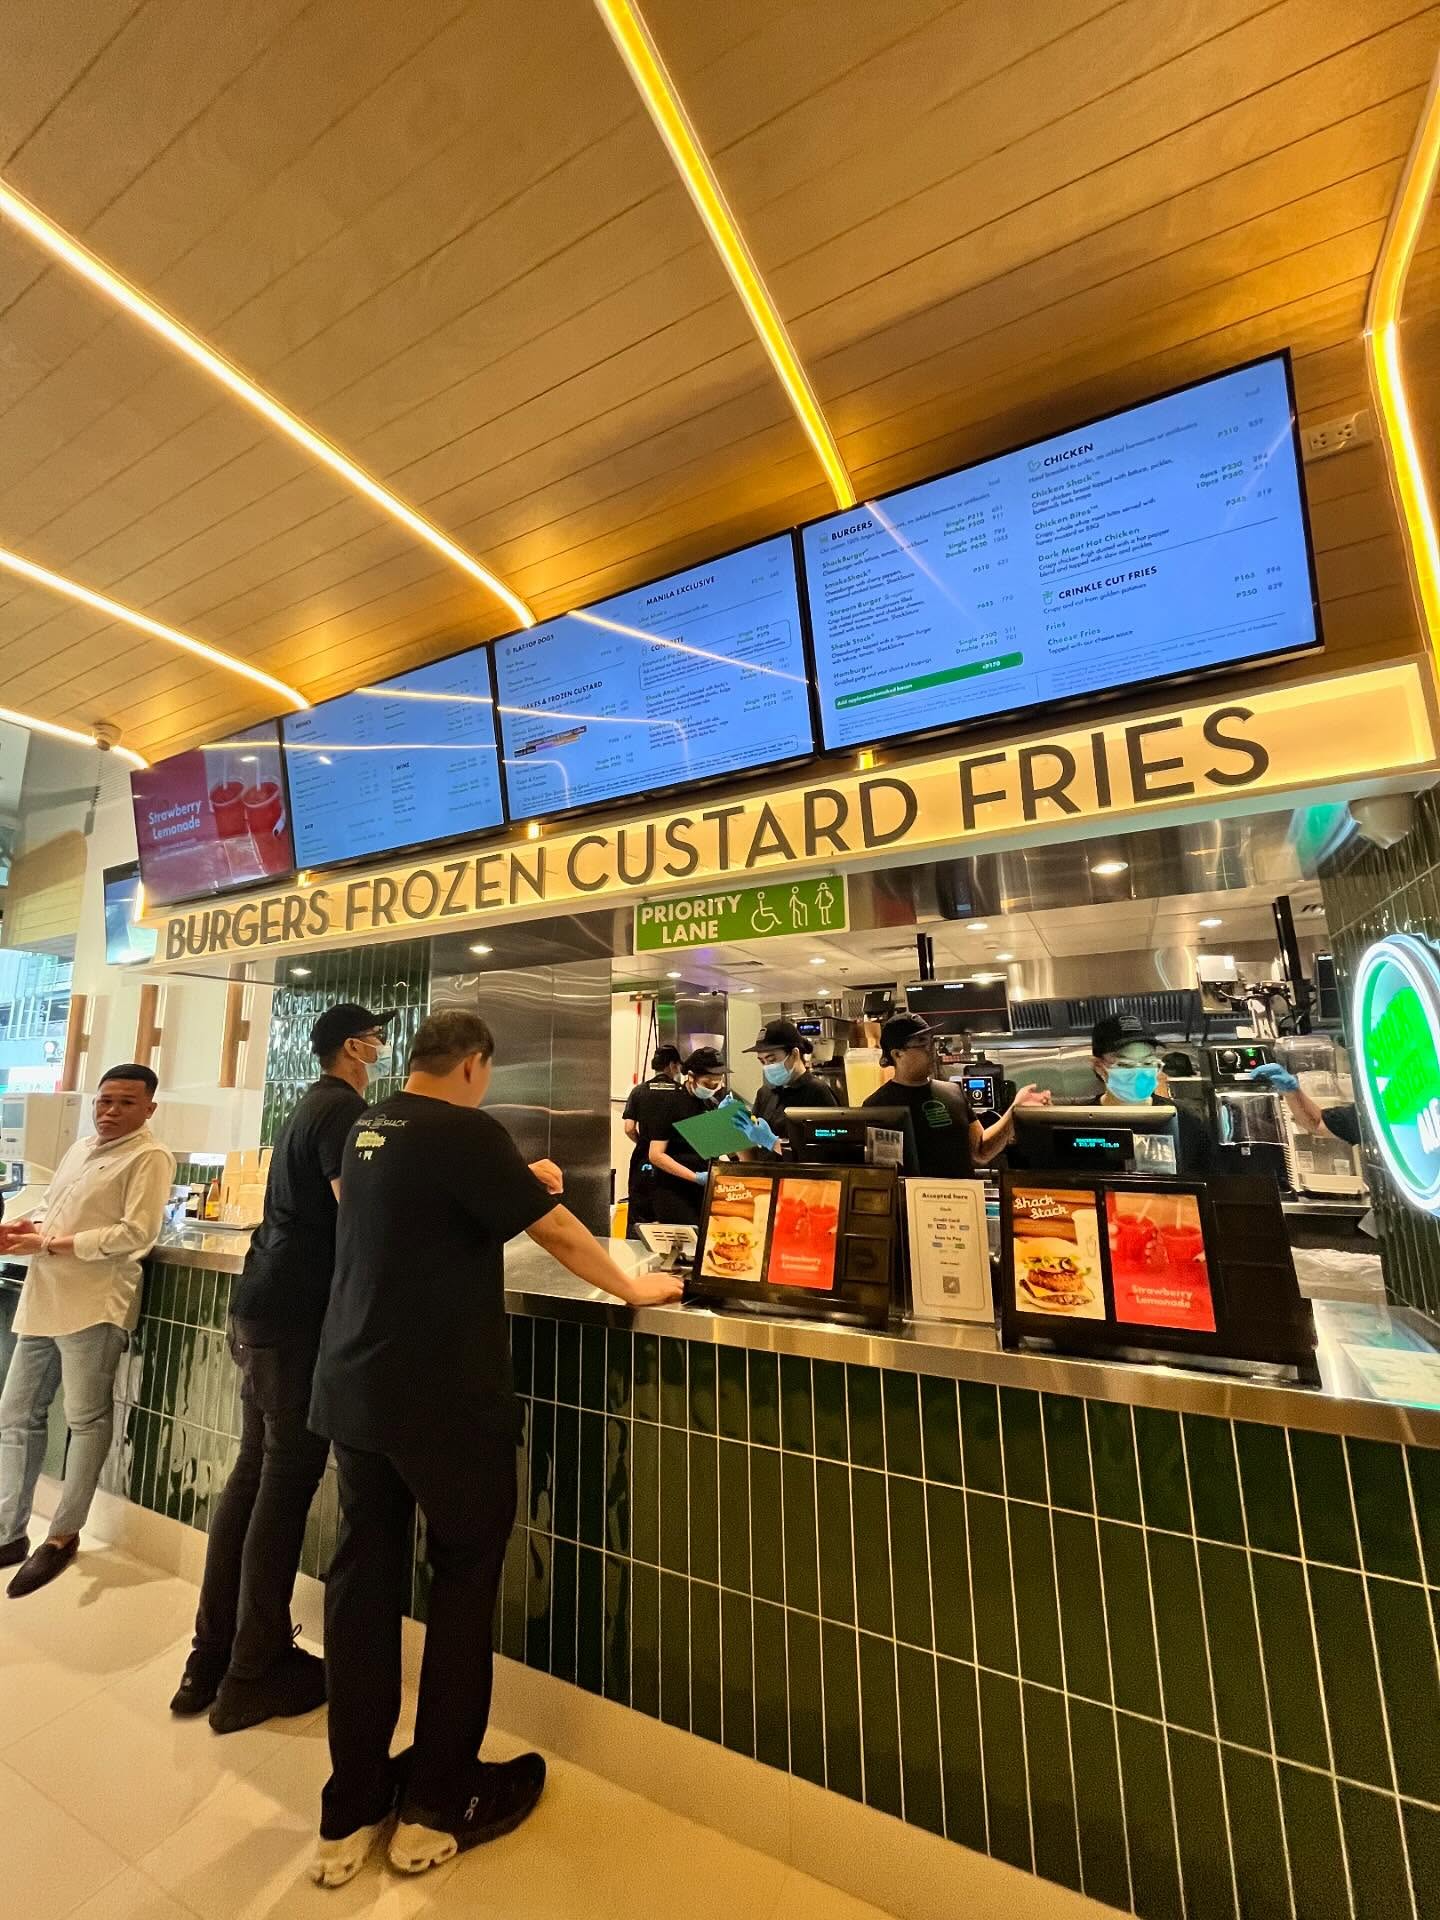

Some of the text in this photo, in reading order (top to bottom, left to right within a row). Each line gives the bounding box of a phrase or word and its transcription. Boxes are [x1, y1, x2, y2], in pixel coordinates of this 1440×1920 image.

[1043, 443, 1093, 467] CHICKEN
[1031, 483, 1064, 499] Chicken
[831, 520, 872, 540] BURGERS
[1034, 515, 1068, 531] Chicken
[1085, 523, 1099, 531] BBQ
[1038, 527, 1140, 562] Dark Meat Hot Chicken
[646, 576, 714, 605] MANILA EXCLUSIVE
[1058, 566, 1157, 599] CRINKLE CUT FRIES
[857, 597, 881, 609] Burger
[1045, 621, 1066, 631] Fries
[537, 634, 554, 644] DOGS
[1047, 627, 1101, 645] Cheese Fries
[830, 640, 851, 650] Shack
[833, 663, 873, 679] Hamburger
[547, 690, 573, 702] FROZEN
[573, 681, 602, 695] CUSTARD
[148, 800, 202, 826] Strawberry
[152, 816, 201, 840] Lemonade
[166, 889, 331, 960] BURGERS
[346, 846, 547, 931] FROZEN
[566, 777, 918, 893] CUSTARD
[959, 706, 1270, 830] FRIES
[640, 892, 741, 926] PRIORITY
[661, 918, 719, 944] LANE
[876, 1130, 900, 1142] BIR
[715, 1182, 746, 1193] Shack
[725, 1190, 753, 1202] Stack
[922, 1192, 952, 1200] Accepted
[1014, 1195, 1055, 1210] Shack
[1030, 1205, 1069, 1220] Stack
[780, 1252, 822, 1265] Strawberry
[780, 1261, 819, 1271] Lemonade
[1132, 1284, 1193, 1300] Strawberry
[1136, 1296, 1191, 1309] Lemonade
